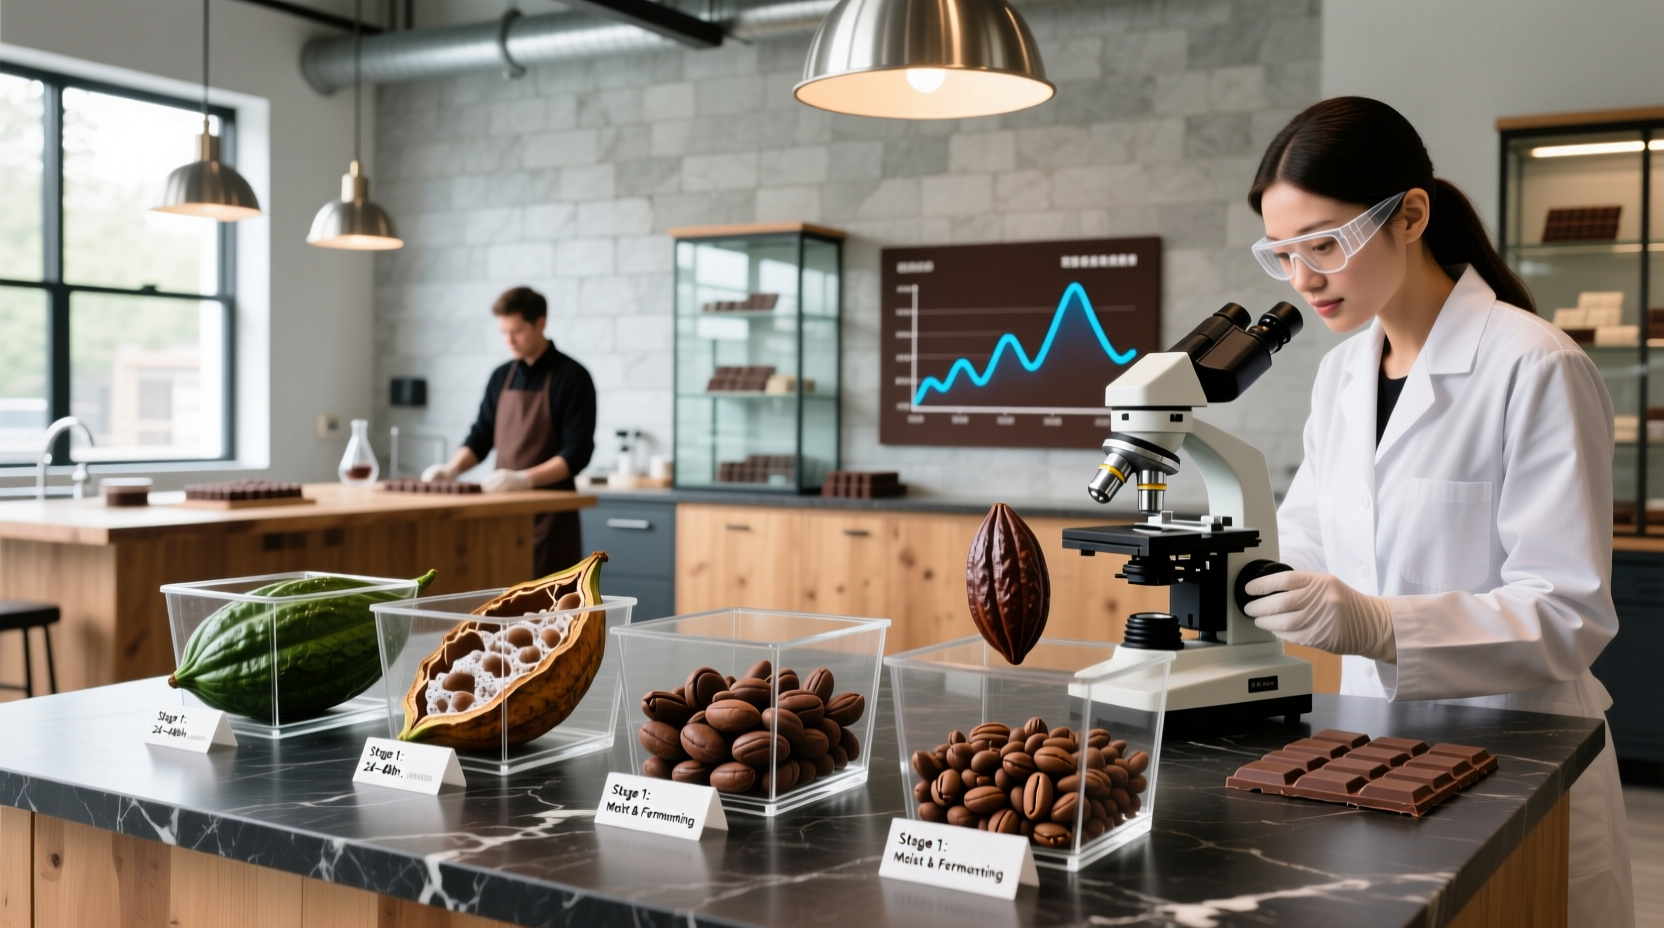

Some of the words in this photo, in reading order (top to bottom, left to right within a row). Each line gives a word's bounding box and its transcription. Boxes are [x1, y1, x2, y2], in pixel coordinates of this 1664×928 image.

[641, 788, 651, 800] 1:
[898, 832, 933, 852] Stage
[937, 839, 948, 852] 1:
